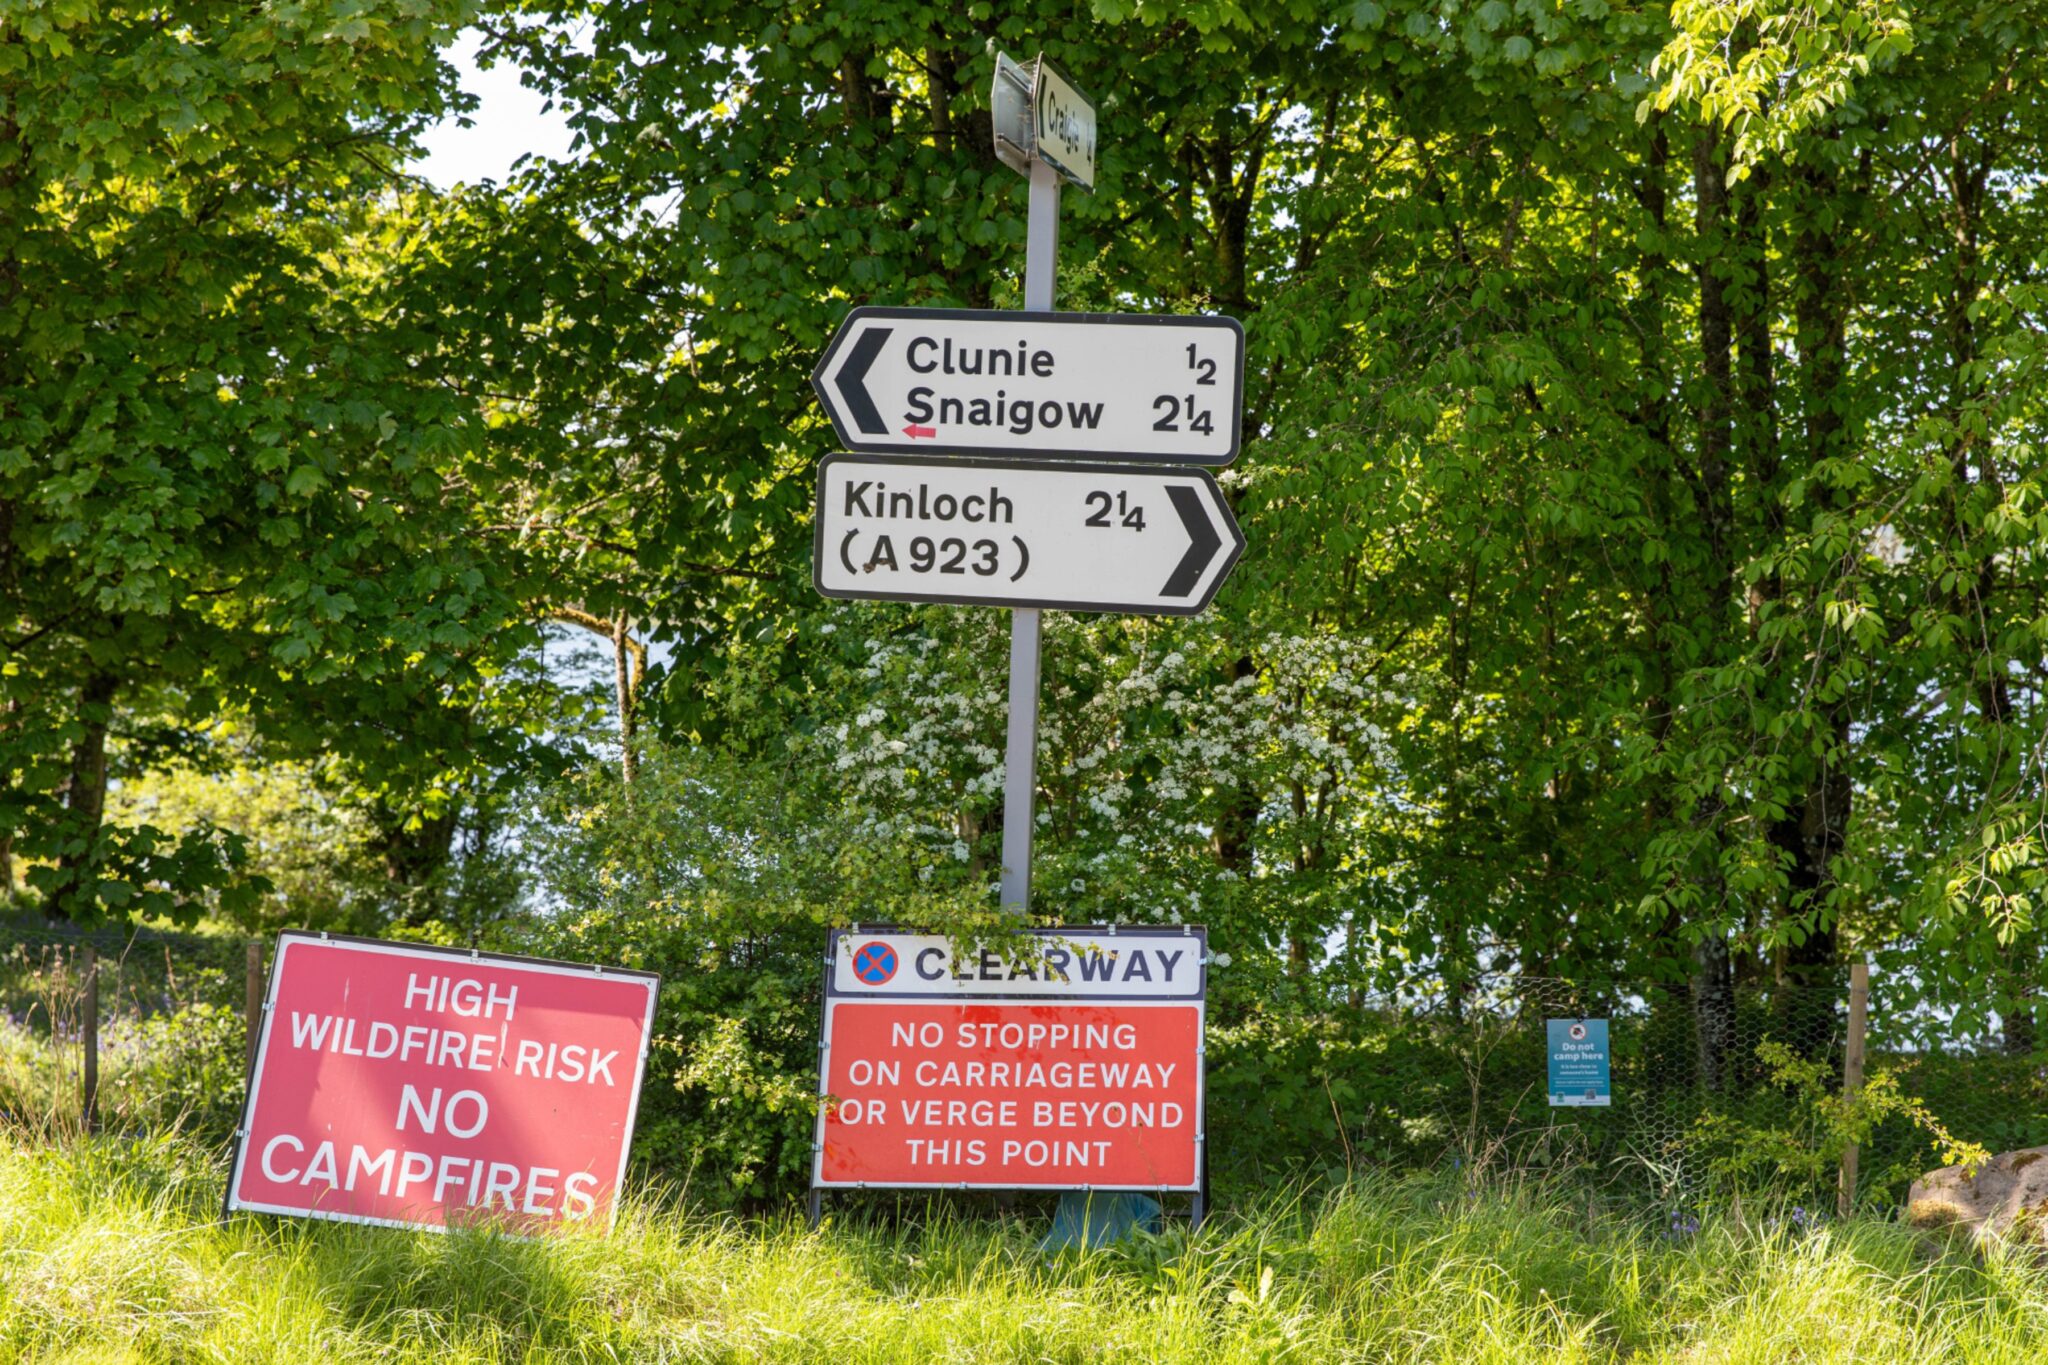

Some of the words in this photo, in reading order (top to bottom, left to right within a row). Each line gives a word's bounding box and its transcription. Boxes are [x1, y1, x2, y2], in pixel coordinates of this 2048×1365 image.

[906, 336, 1055, 377] Clunie
[903, 387, 1104, 434] Snaigow
[843, 481, 1013, 524] Kinloch
[404, 973, 518, 1021] HIGH
[291, 1012, 496, 1072] WILDFIRE
[514, 1040, 619, 1086] RISK
[892, 1022, 944, 1048] NO
[957, 1023, 1136, 1050] STOPPING
[1562, 1043, 1576, 1051] Do
[1582, 1052, 1604, 1060] here
[849, 1060, 900, 1086] ON
[915, 1061, 1176, 1089] CARRIAGEWAY
[395, 1084, 488, 1139] NO
[839, 1099, 886, 1125] OR
[901, 1100, 1017, 1126] VERGE
[1033, 1102, 1183, 1128] BEYOND
[906, 1139, 986, 1165] THIS
[1002, 1141, 1112, 1167] POINT
[261, 1134, 598, 1221] CAMPFIRES
